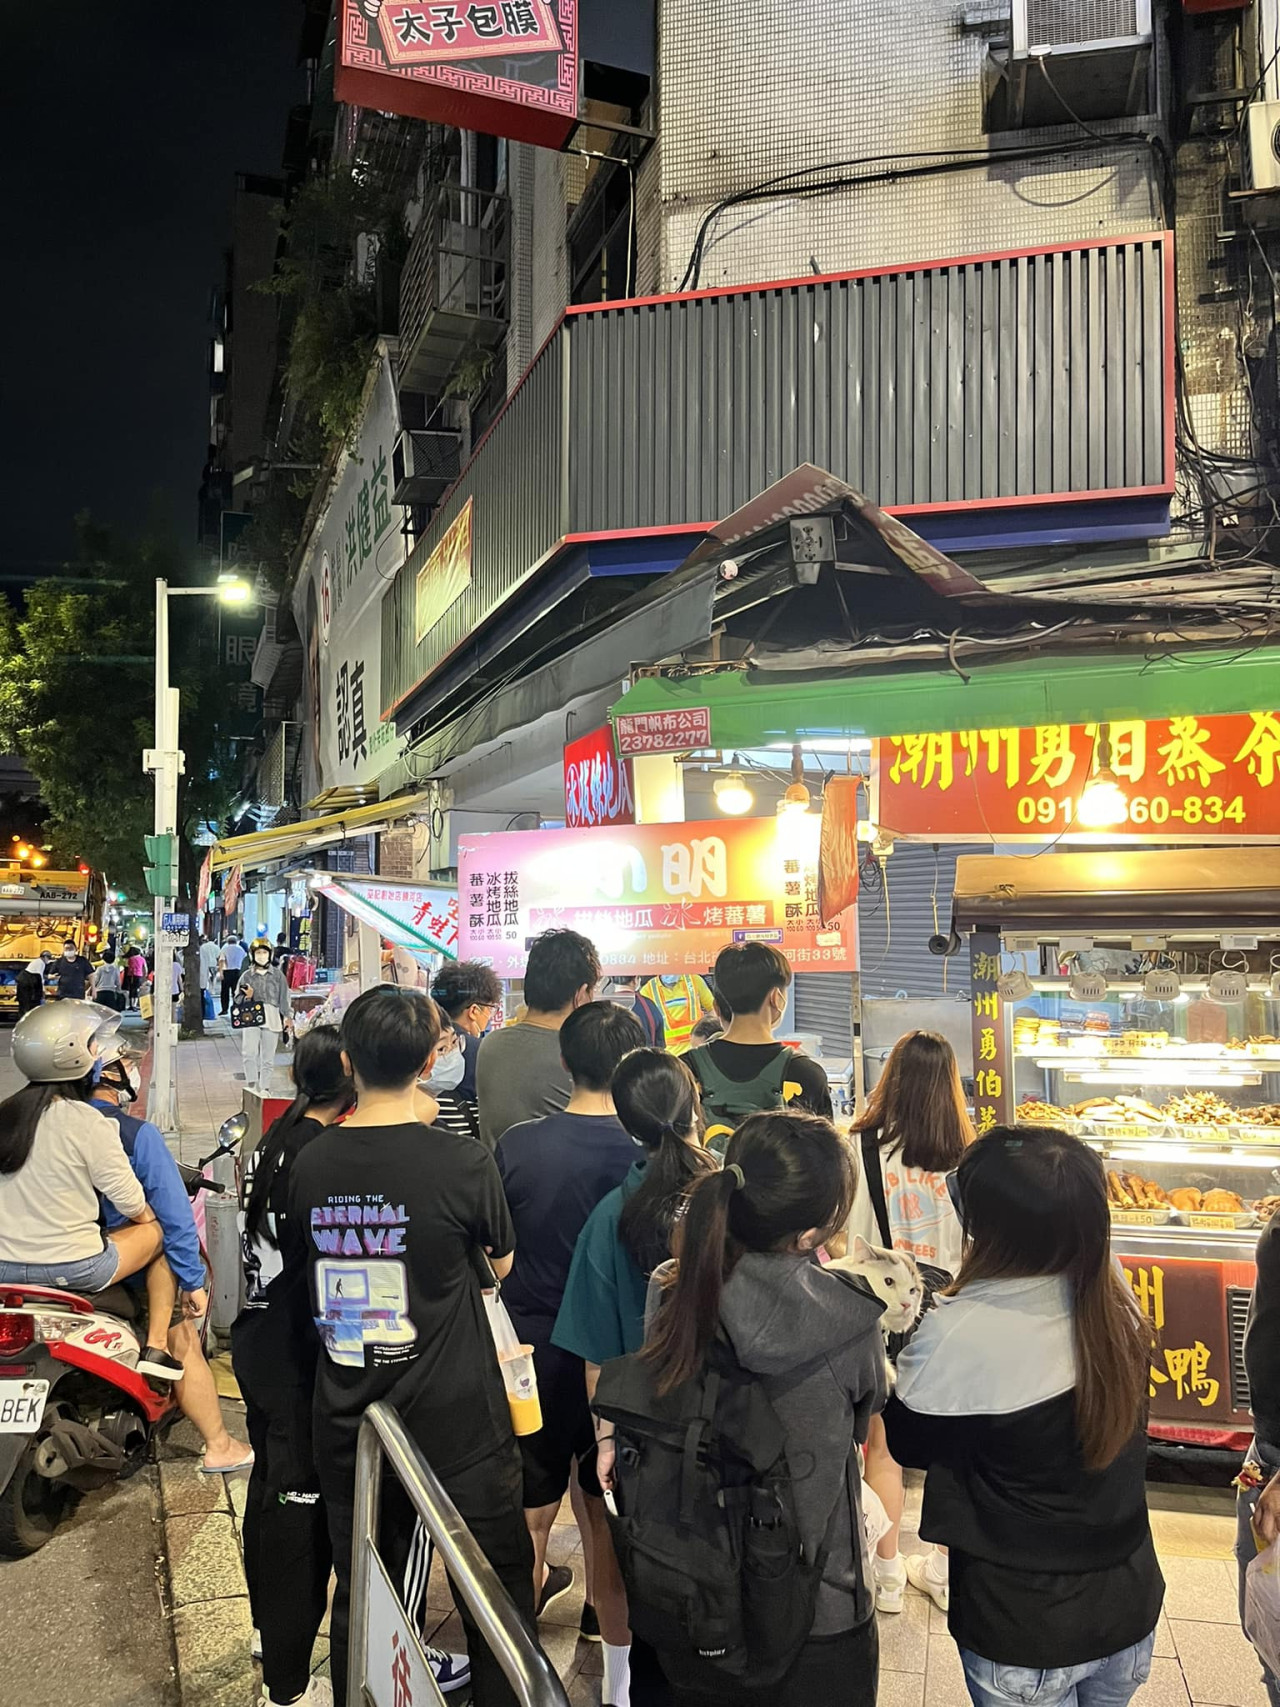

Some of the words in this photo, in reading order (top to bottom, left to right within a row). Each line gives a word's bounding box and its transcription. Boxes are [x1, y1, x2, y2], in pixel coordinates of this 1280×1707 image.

[394, 0, 539, 45] 太子包膜
[345, 444, 391, 589] 洪健益
[336, 660, 367, 770] 認真
[619, 710, 708, 736] 龍門帆布公司
[620, 729, 708, 751] 23782277
[1017, 795, 1246, 825] 09160-834
[469, 872, 485, 928] 蕃薯酥
[486, 872, 501, 927] 冰烤地瓜
[503, 870, 519, 926] 拔絲地瓜
[660, 897, 701, 931] 冰
[703, 904, 767, 927] 烤蕃薯
[827, 921, 840, 931] 50
[505, 930, 518, 940] 50
[973, 951, 1002, 1136] 潮州勇伯蒸
[328, 1195, 361, 1204] RIDING
[365, 1194, 384, 1203] THE
[311, 1204, 411, 1226] ETERNAL
[312, 1227, 408, 1256] WAVE
[0, 1397, 41, 1423] BEK
